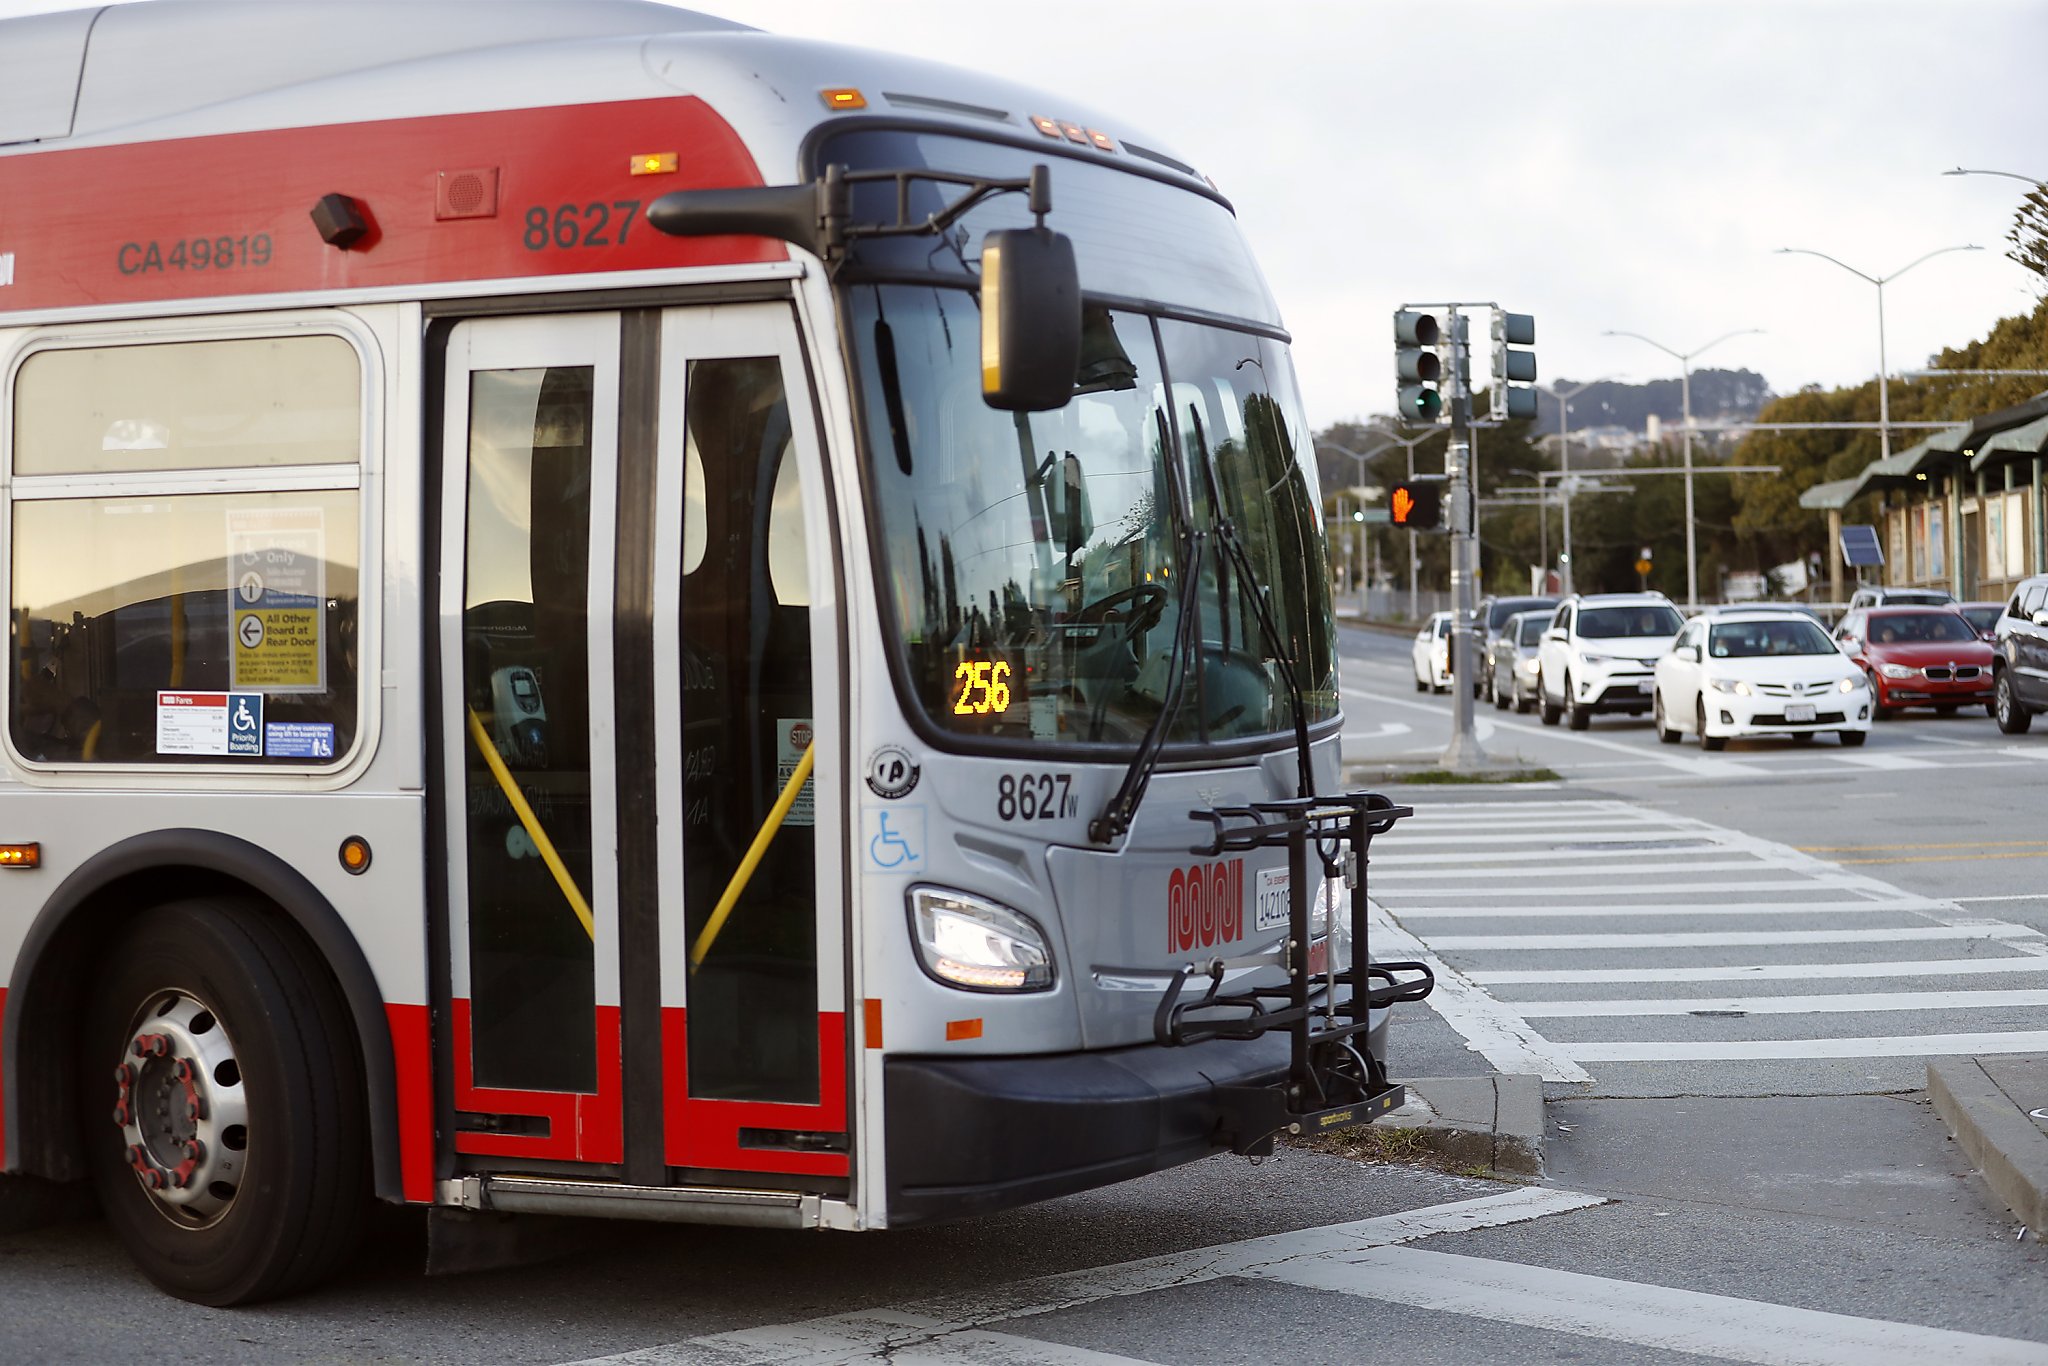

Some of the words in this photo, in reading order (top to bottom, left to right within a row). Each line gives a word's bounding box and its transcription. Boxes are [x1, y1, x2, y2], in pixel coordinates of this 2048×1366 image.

[523, 200, 641, 252] 8627
[266, 551, 296, 566] Only
[267, 614, 280, 623] All
[282, 614, 311, 623] Other
[267, 626, 295, 635] Board
[298, 627, 308, 635] at
[267, 638, 288, 647] Rear
[291, 638, 317, 646] Door
[954, 660, 1012, 715] 256
[175, 695, 193, 704] Fares
[268, 724, 287, 732] Please
[231, 732, 257, 744] Priority
[791, 730, 812, 744] STOP
[229, 742, 259, 754] Boarding
